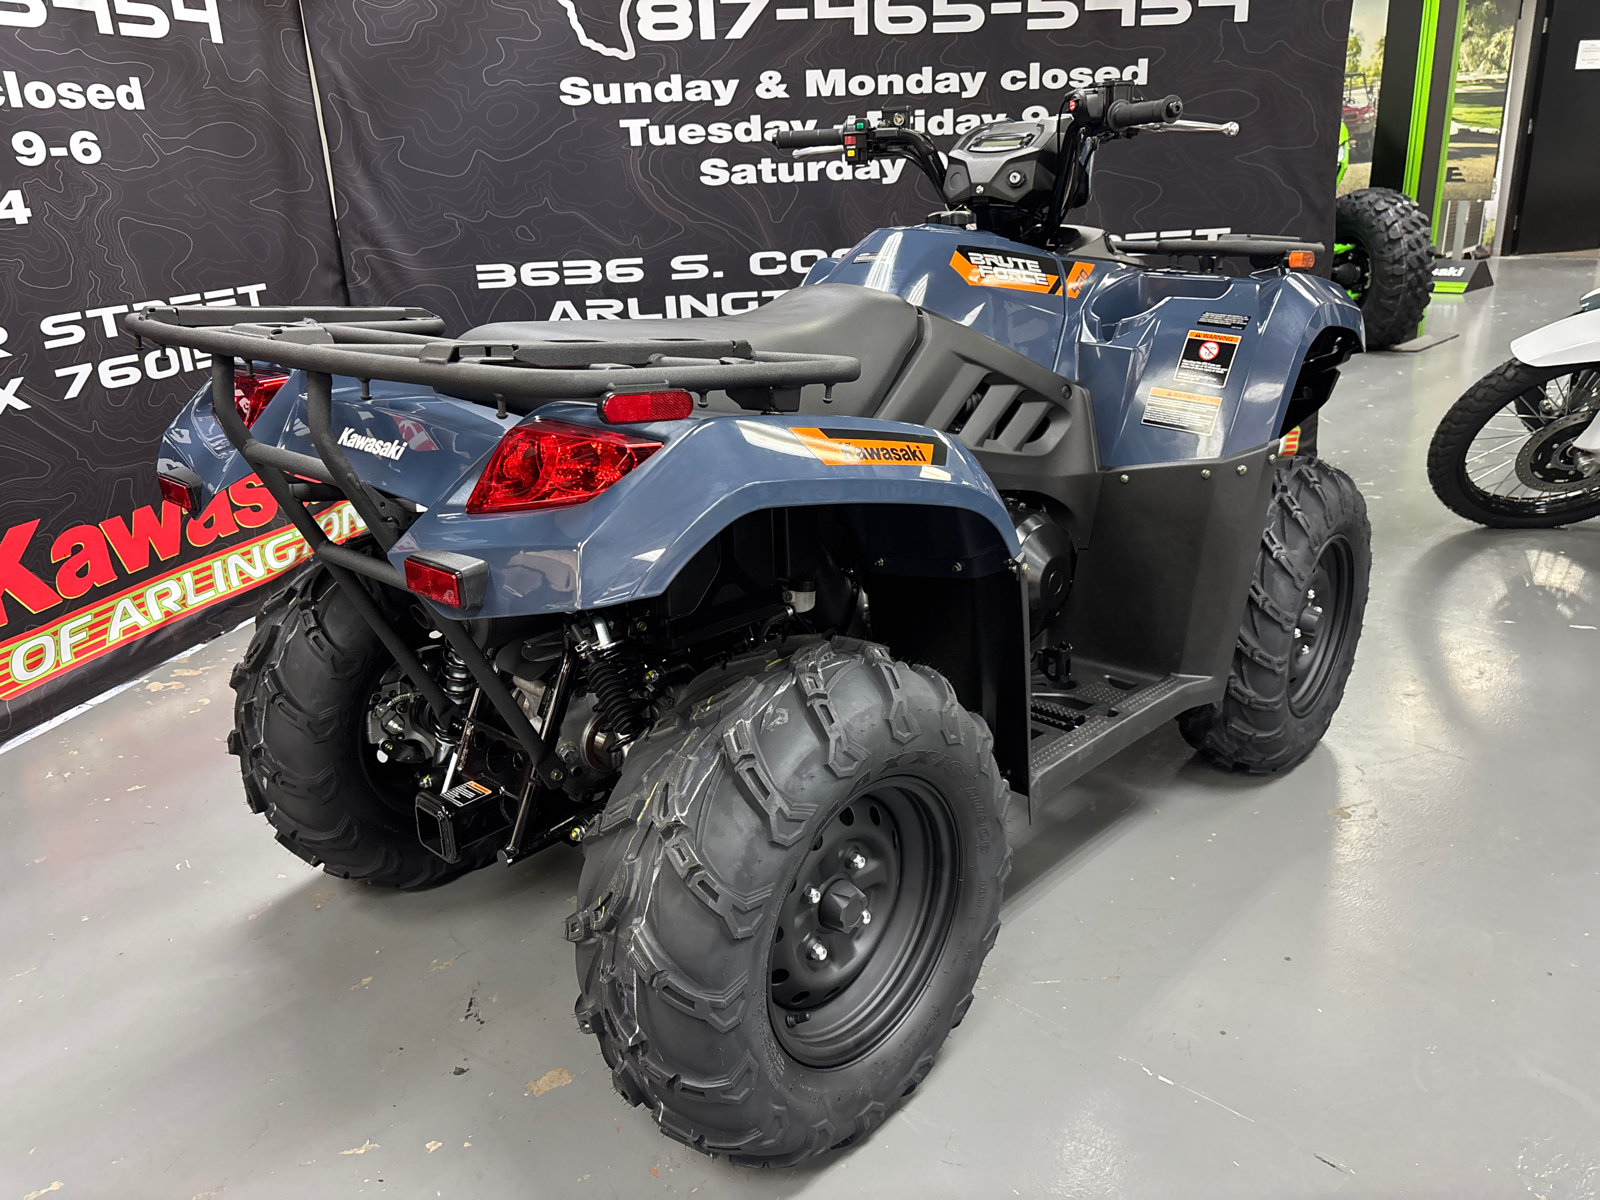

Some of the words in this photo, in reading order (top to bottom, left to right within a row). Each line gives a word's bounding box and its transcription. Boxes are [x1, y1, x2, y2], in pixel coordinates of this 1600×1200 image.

[0, 71, 146, 110] losed
[559, 73, 740, 106] Sunday
[755, 70, 790, 99] &
[805, 66, 987, 98] Monday
[1000, 58, 1149, 92] closed
[11, 130, 102, 167] 9-6
[700, 153, 906, 186] Saturday
[475, 257, 645, 289] 3636
[670, 254, 724, 280] S.
[968, 252, 1041, 272] BRUTE
[977, 265, 1049, 285] FORCE
[1203, 333, 1234, 342] WARNING
[1173, 391, 1201, 402] WARNING
[337, 426, 408, 461] Kawasaki
[838, 442, 927, 462] Kawasaki
[0, 471, 280, 628] Kawas
[11, 612, 93, 683] OF
